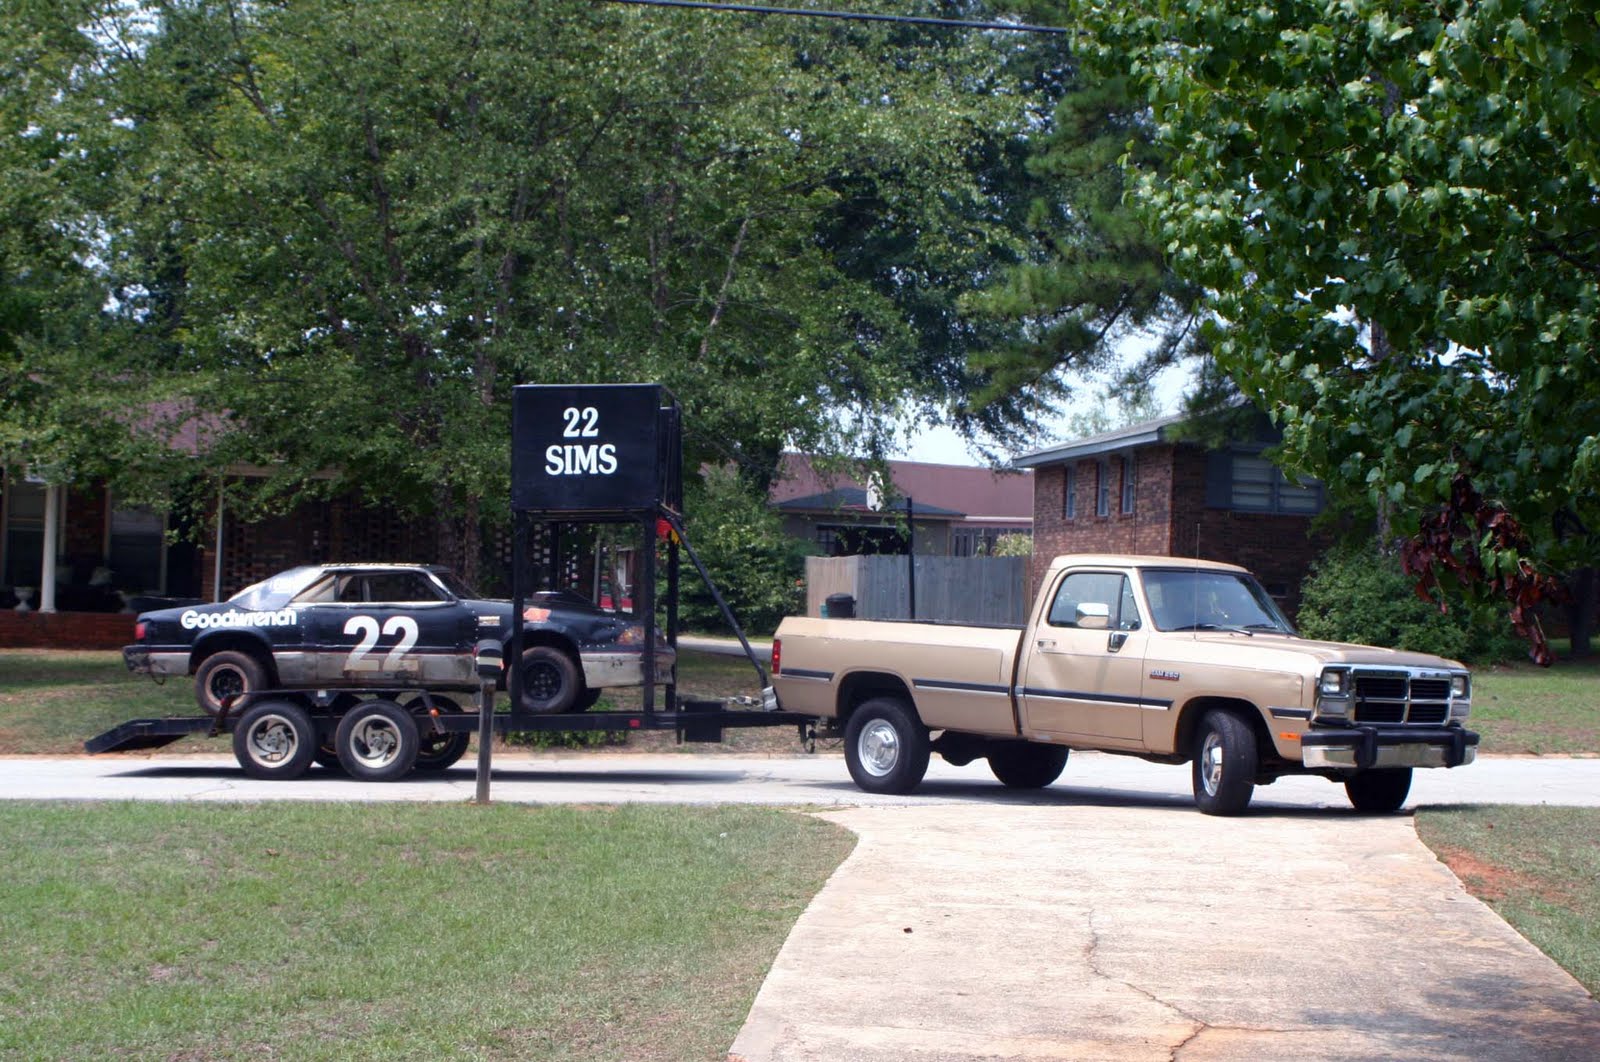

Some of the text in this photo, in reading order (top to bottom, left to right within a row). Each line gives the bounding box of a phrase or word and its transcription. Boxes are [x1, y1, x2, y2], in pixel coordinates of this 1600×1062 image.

[563, 407, 599, 437] 22
[545, 444, 618, 475] SIMS
[181, 609, 297, 629] Goodwrench
[343, 615, 419, 672] 22
